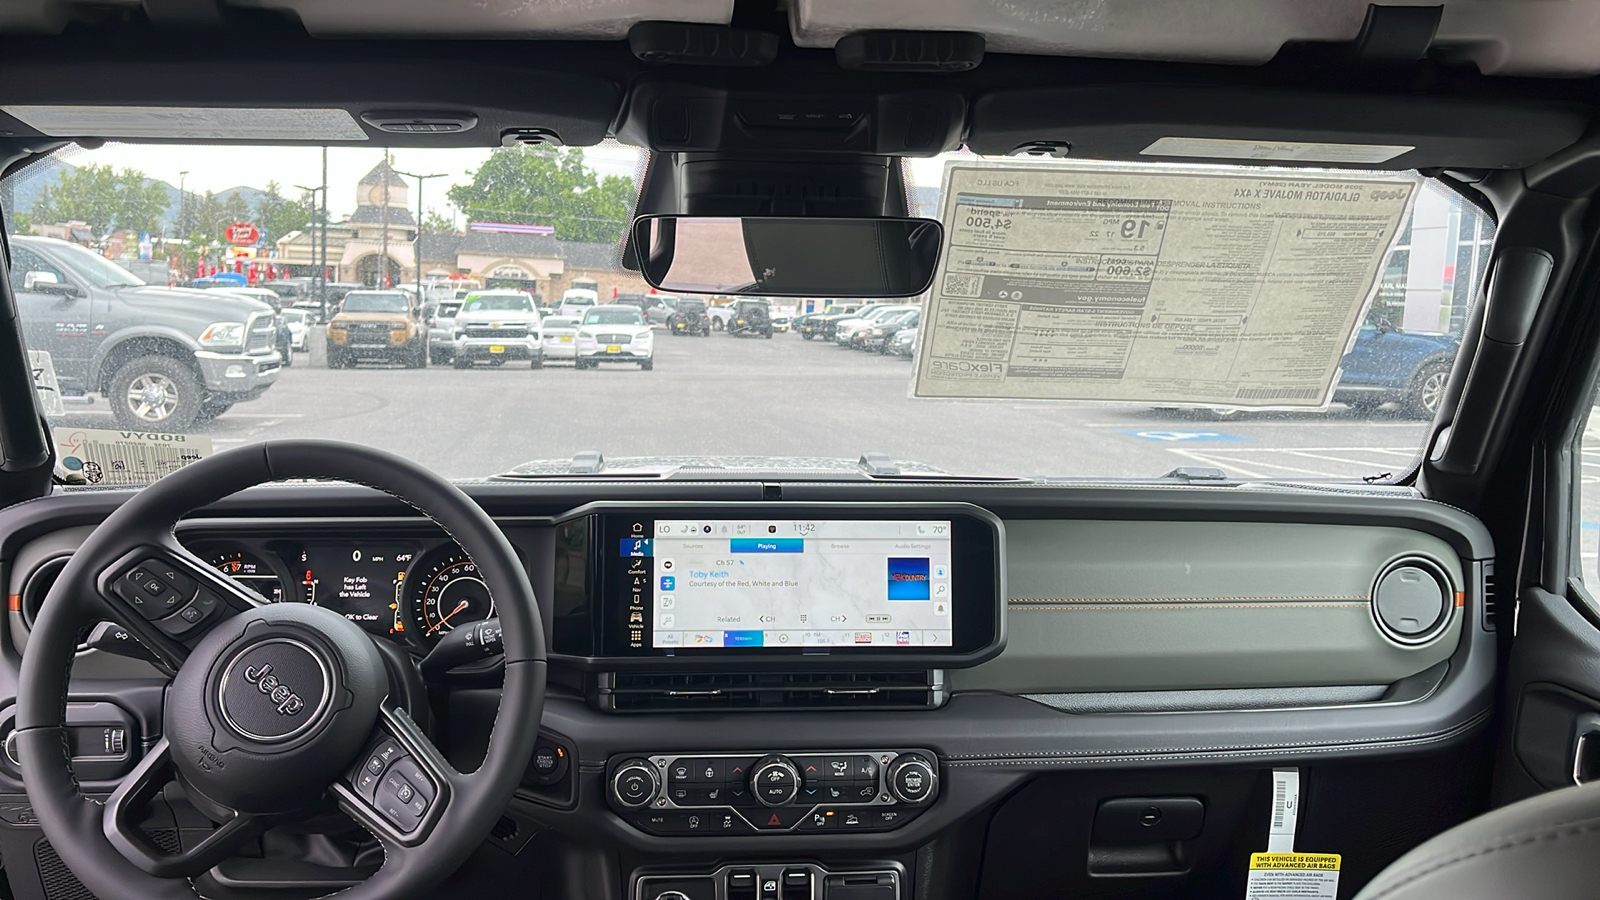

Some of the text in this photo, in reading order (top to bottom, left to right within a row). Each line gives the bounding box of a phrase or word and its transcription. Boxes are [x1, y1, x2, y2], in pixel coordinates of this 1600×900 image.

[793, 524, 815, 532] 11:42
[353, 550, 361, 561] 0
[464, 564, 475, 572] 60
[690, 571, 708, 579] Toby
[150, 583, 159, 591] OK
[244, 662, 305, 716] Jeep
[198, 745, 225, 769] AIRBAG
